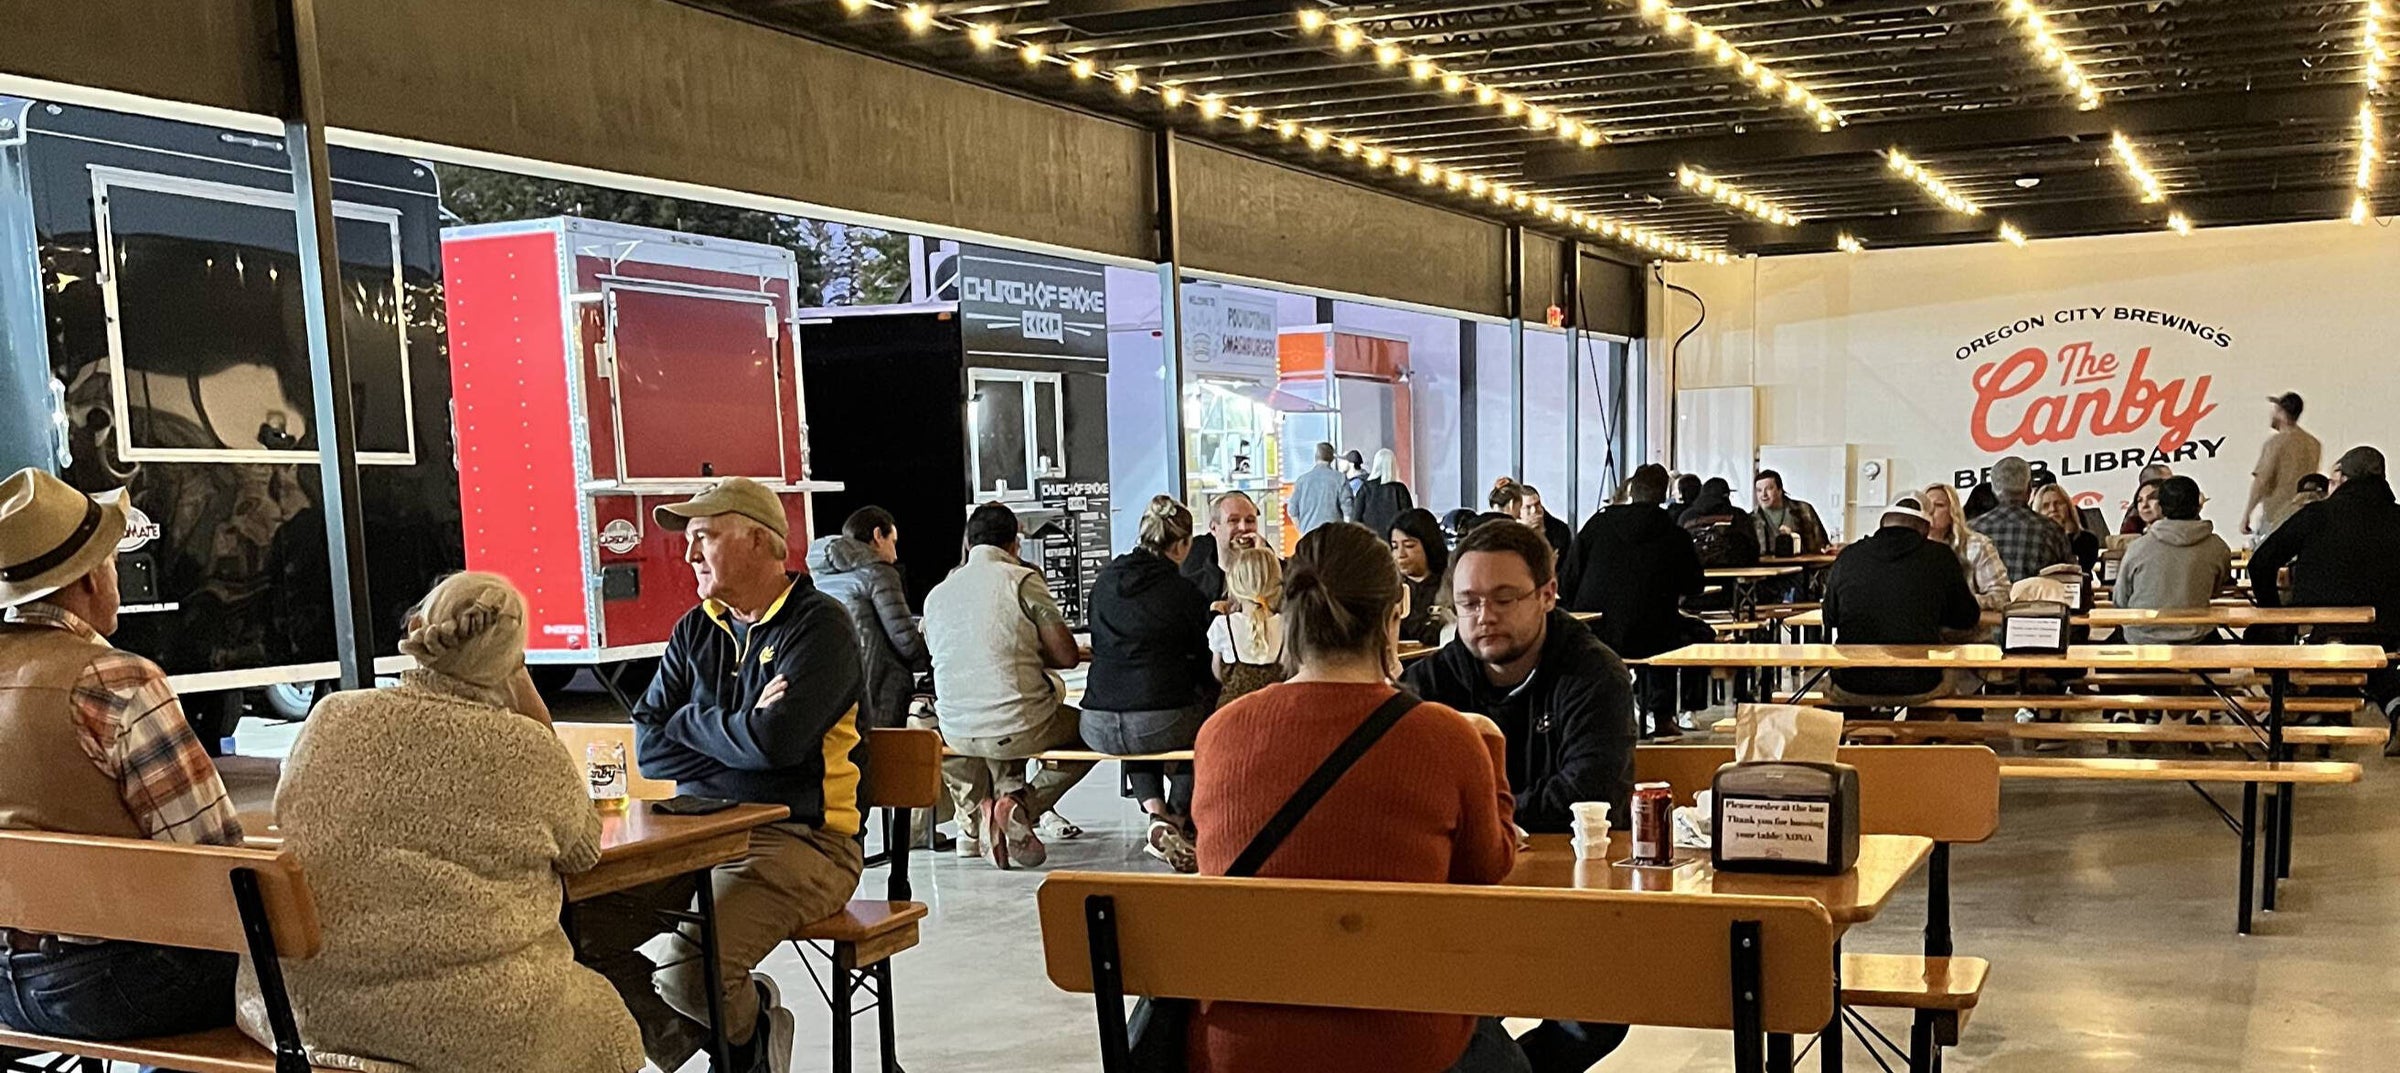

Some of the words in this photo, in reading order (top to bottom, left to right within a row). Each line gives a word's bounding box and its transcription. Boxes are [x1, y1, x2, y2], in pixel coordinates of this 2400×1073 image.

[963, 276, 1034, 306] CHURCH
[1034, 280, 1058, 310] OF
[1058, 285, 1105, 314] SMOKE
[1022, 310, 1064, 344] BBQ
[1955, 315, 2045, 361] OREGON
[2053, 307, 2107, 324] CITY
[2113, 307, 2232, 348] BREWING'S
[2058, 341, 2120, 387] The
[1970, 346, 2218, 453] Canby
[2061, 436, 2227, 476] LIBRARY
[1726, 800, 1753, 809] Please
[1754, 802, 1779, 810] order
[1792, 804, 1807, 812] the
[1727, 815, 1755, 824] Thank
[1757, 818, 1773, 828] you
[1774, 817, 1788, 825] for
[1736, 832, 1756, 840] your
